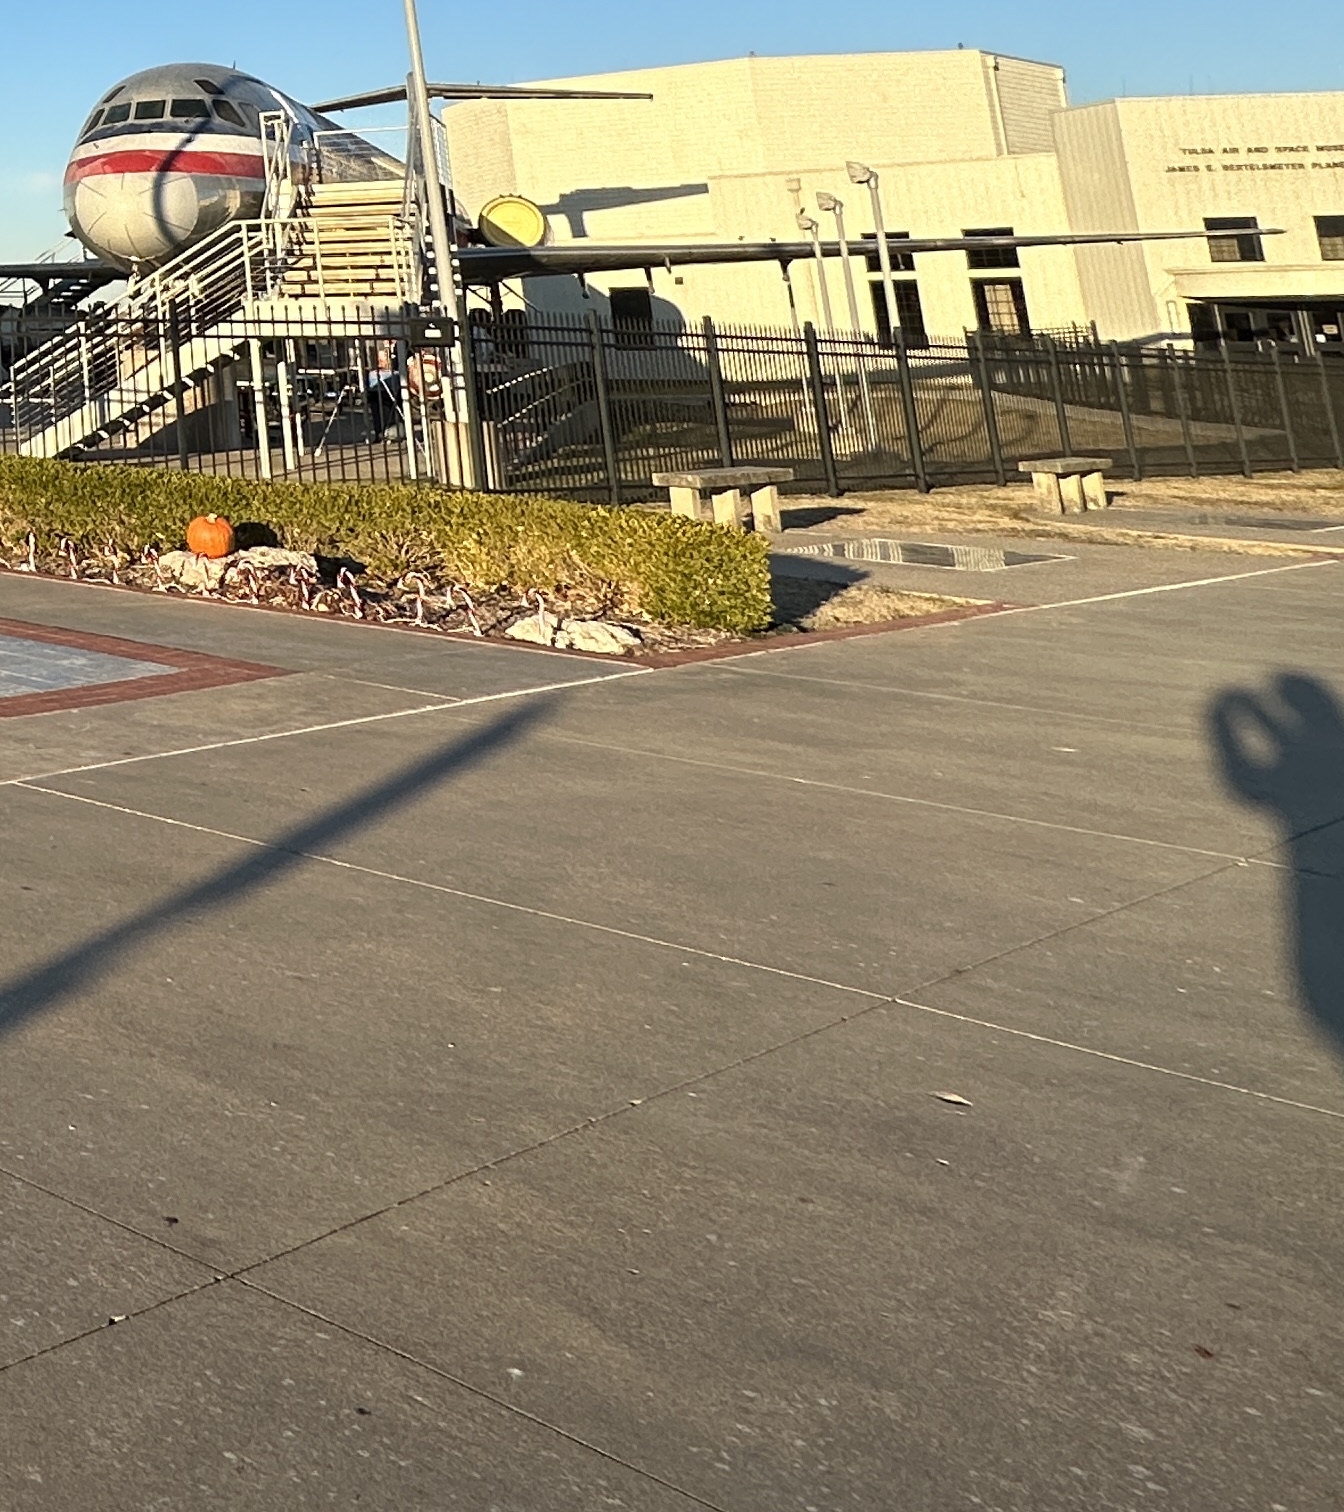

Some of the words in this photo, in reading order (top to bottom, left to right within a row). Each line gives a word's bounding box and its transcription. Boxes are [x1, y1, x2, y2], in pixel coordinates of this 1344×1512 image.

[1180, 147, 1215, 156] TULSA
[1222, 147, 1240, 155] AIR
[1246, 146, 1269, 154] AND
[1274, 145, 1310, 153] SPACE
[1165, 164, 1200, 173] JAMES
